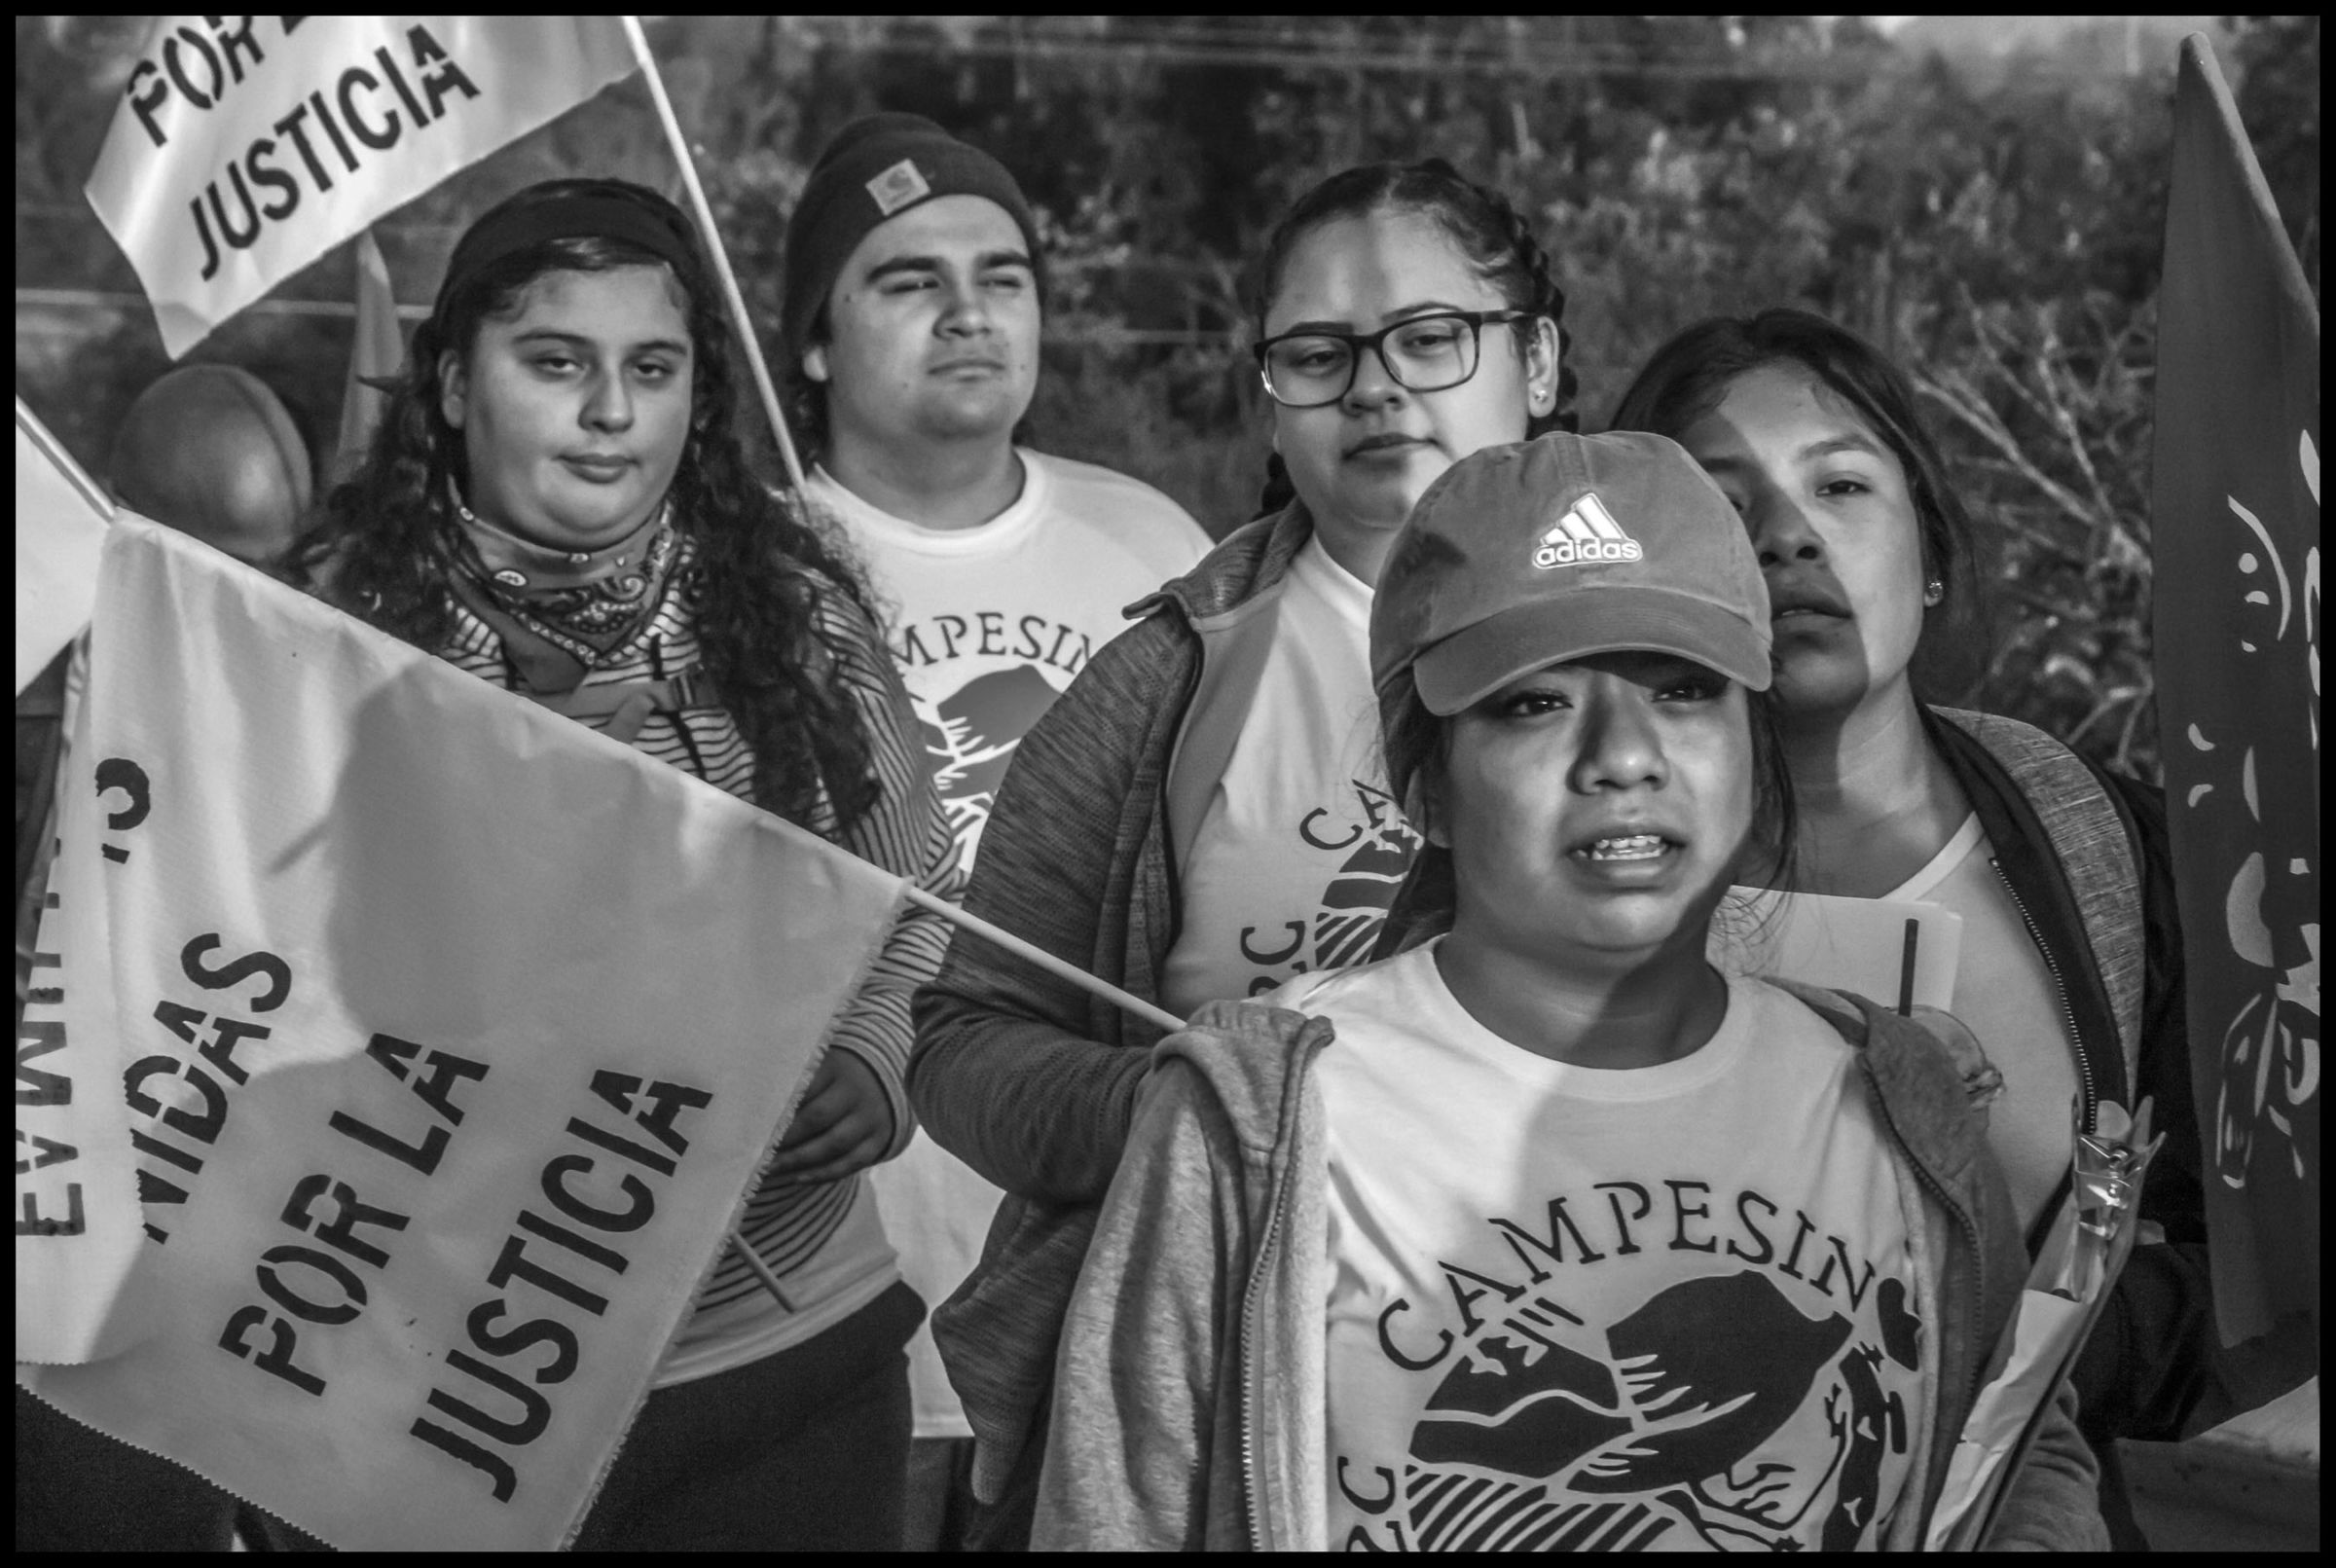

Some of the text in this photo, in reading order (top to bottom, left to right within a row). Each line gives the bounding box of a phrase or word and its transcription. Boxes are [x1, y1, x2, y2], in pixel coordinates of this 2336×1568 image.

[128, 16, 264, 148] POR
[189, 23, 482, 282] JUSTICIA
[891, 611, 1091, 675] MPESIN
[1535, 536, 1640, 566] adidas
[123, 931, 293, 1245] IDAS
[217, 1032, 491, 1397] POR LA
[409, 1069, 713, 1505] JUSTICIA
